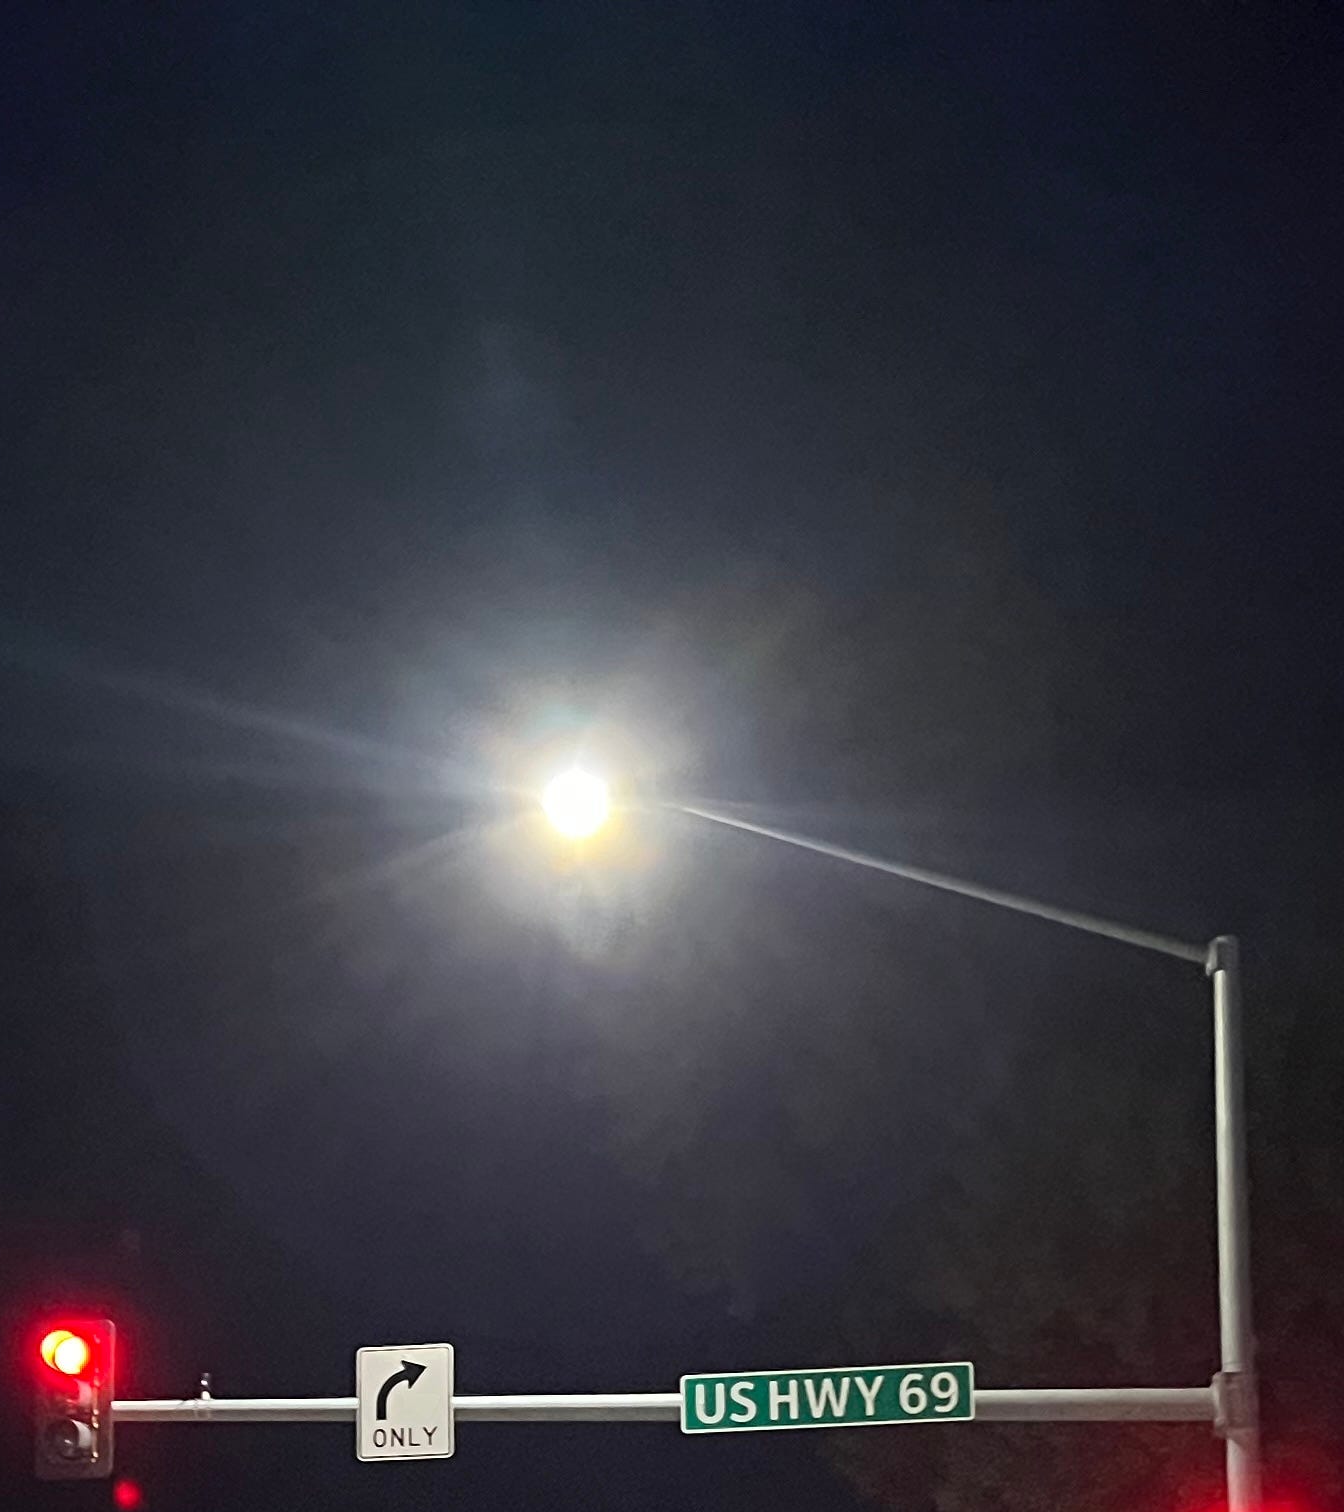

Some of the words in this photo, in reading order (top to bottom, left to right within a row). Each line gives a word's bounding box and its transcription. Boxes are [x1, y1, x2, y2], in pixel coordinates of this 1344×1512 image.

[694, 1381, 756, 1425] US
[768, 1374, 885, 1421] HWY
[898, 1371, 960, 1415] 69
[372, 1425, 438, 1448] ONLY
